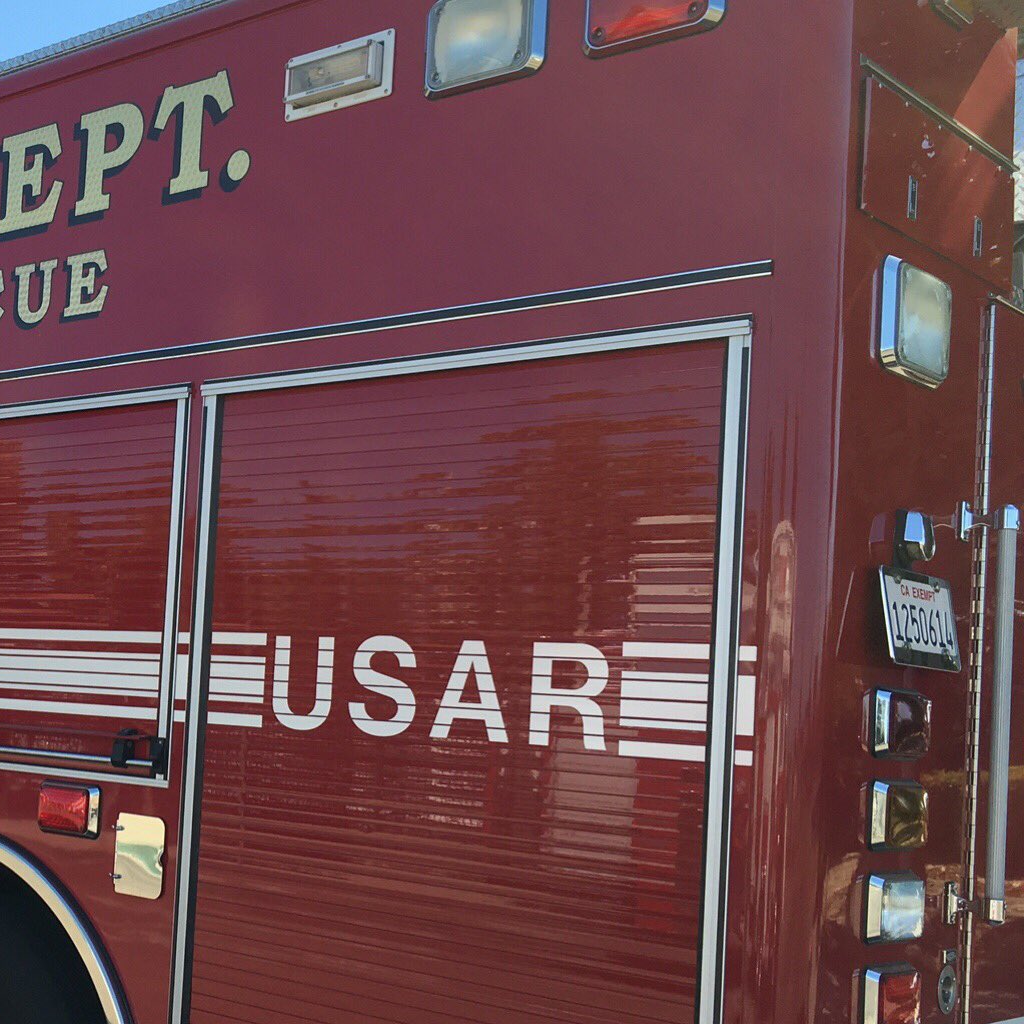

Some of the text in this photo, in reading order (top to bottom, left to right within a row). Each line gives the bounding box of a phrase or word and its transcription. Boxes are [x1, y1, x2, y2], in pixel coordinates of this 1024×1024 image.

[900, 584, 936, 602] CA EXEMPT
[892, 601, 954, 650] 1250614
[272, 634, 608, 751] USAR
